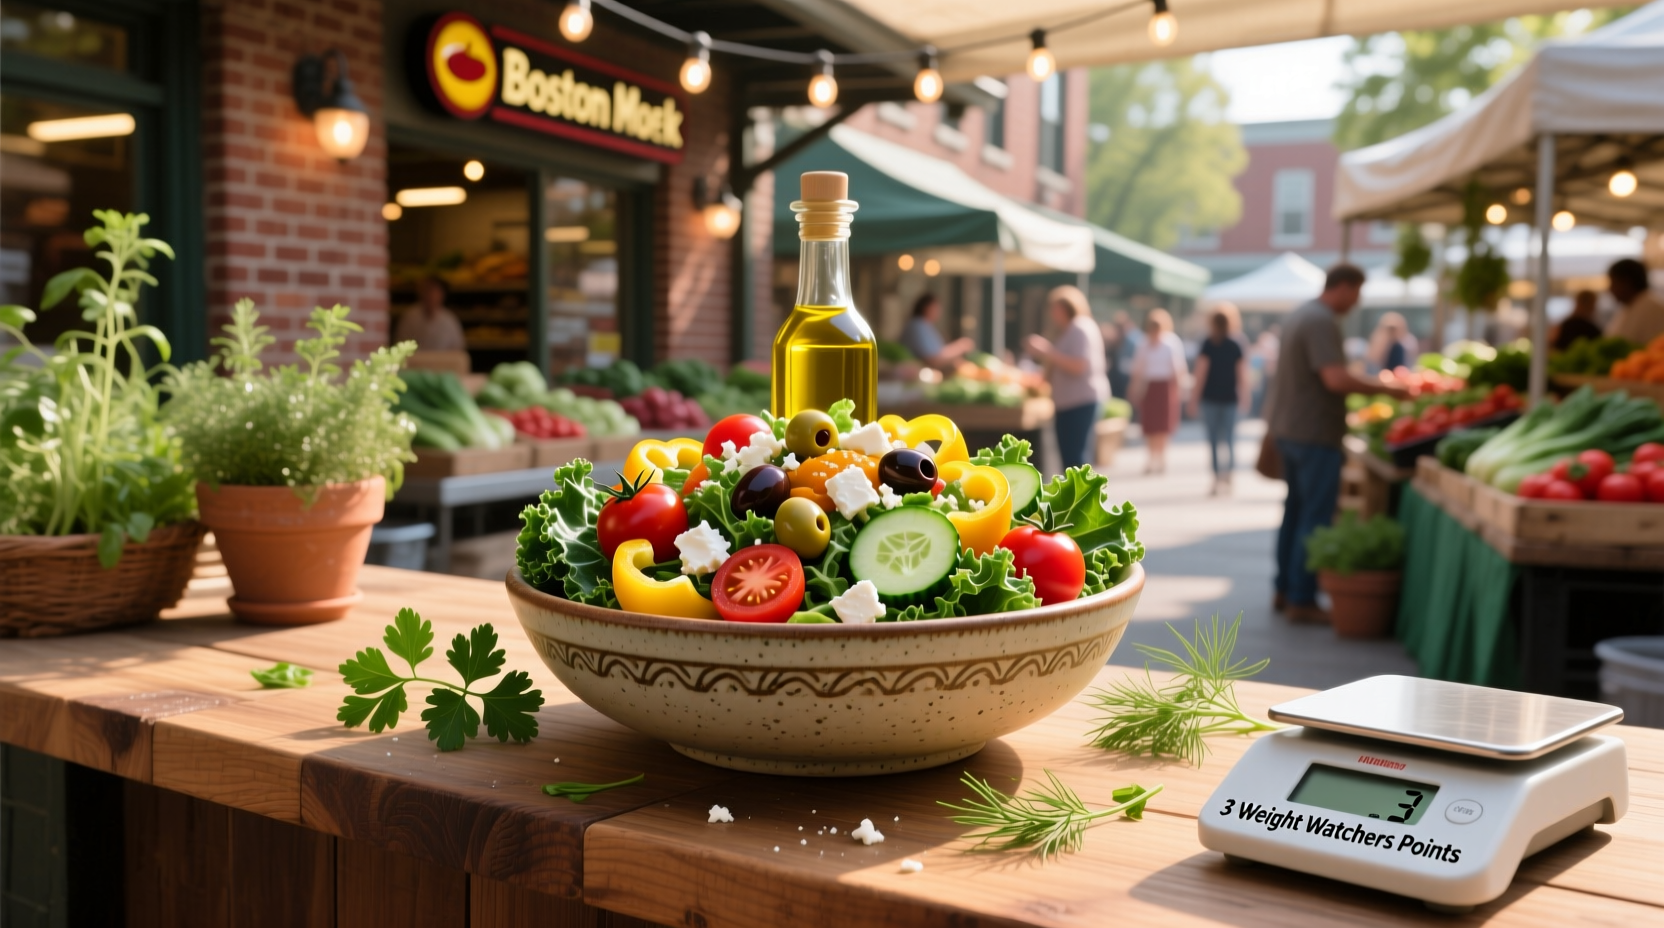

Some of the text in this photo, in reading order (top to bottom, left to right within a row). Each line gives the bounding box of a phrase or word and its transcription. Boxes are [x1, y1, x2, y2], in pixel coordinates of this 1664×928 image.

[501, 46, 612, 130] Boston
[1219, 798, 1462, 864] 3 Weight Watchers Points
[1387, 789, 1424, 824] 3
